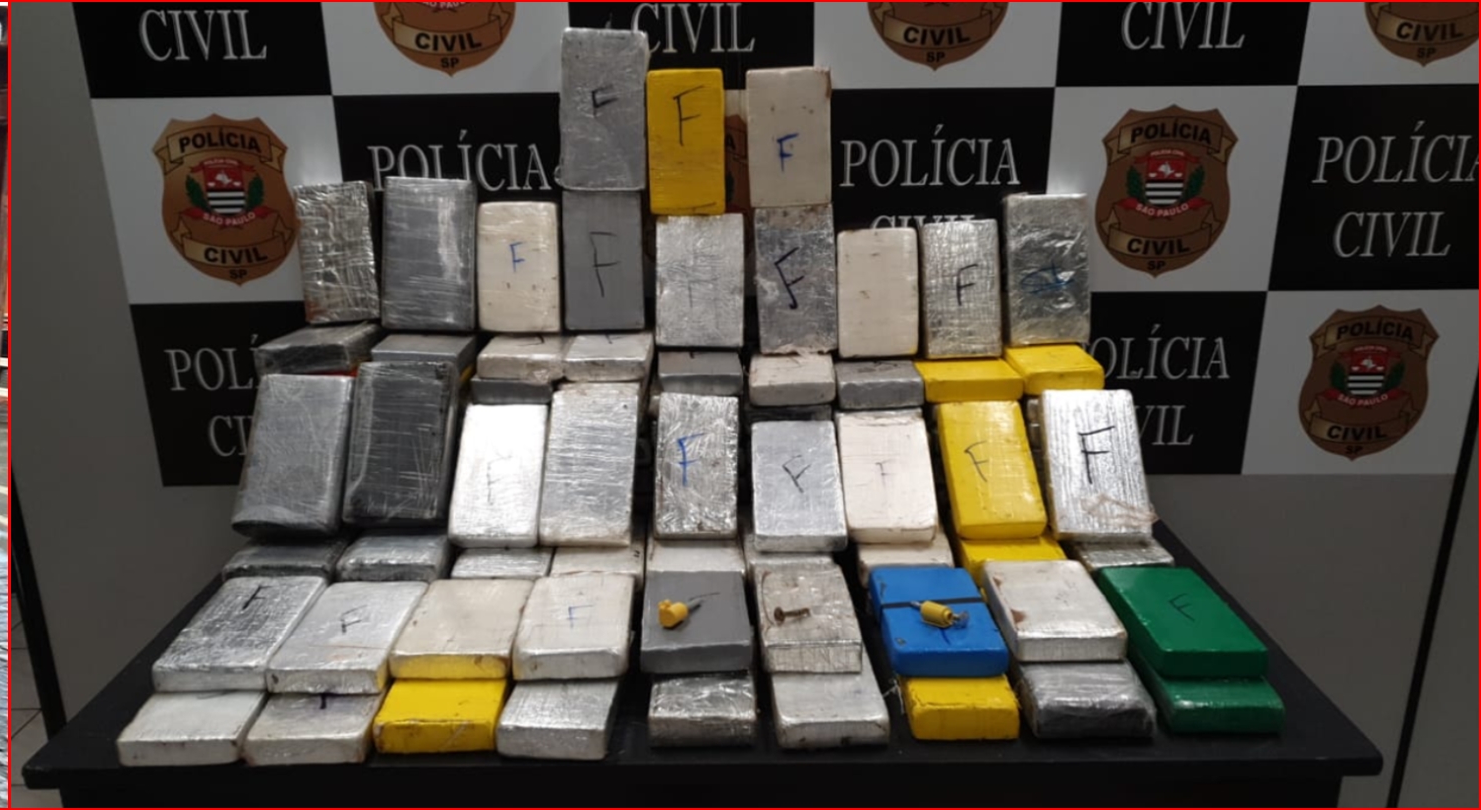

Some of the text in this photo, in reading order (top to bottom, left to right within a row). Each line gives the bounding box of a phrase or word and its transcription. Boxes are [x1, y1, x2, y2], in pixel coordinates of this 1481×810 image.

[139, 9, 267, 61] CIVIL
[903, 26, 970, 46] CIVIL
[1121, 2, 1245, 50] CIVIL
[1396, 22, 1464, 41] CIVIL
[415, 32, 482, 52] CIVIL
[1417, 48, 1436, 59] SP
[441, 57, 459, 68] SP
[926, 52, 945, 63] SP
[673, 85, 705, 146] F
[179, 127, 262, 153] POLÍCIA
[1130, 118, 1212, 144] POLÍCIA
[367, 129, 553, 193] POLÍCIA
[777, 133, 799, 172] F
[839, 124, 1021, 187] POLÍCIA
[225, 211, 255, 226] PAULO
[1157, 203, 1189, 217] PAULO
[1127, 238, 1190, 255] CIVIL
[1333, 211, 1451, 258] CIVIL
[204, 247, 268, 264] CIVIL
[509, 241, 526, 273] F
[589, 231, 621, 298] F
[1147, 260, 1166, 271] SP
[229, 269, 248, 280] SP
[956, 263, 979, 306] F
[1336, 320, 1413, 341] POLÍCIA
[1087, 324, 1230, 380] OLÍCIA
[1327, 425, 1387, 441] CIVIL
[677, 433, 704, 486] F
[964, 440, 989, 483] F
[1078, 426, 1115, 485] F
[1345, 445, 1364, 455] SP
[782, 454, 811, 493] F
[1169, 593, 1195, 622] F
